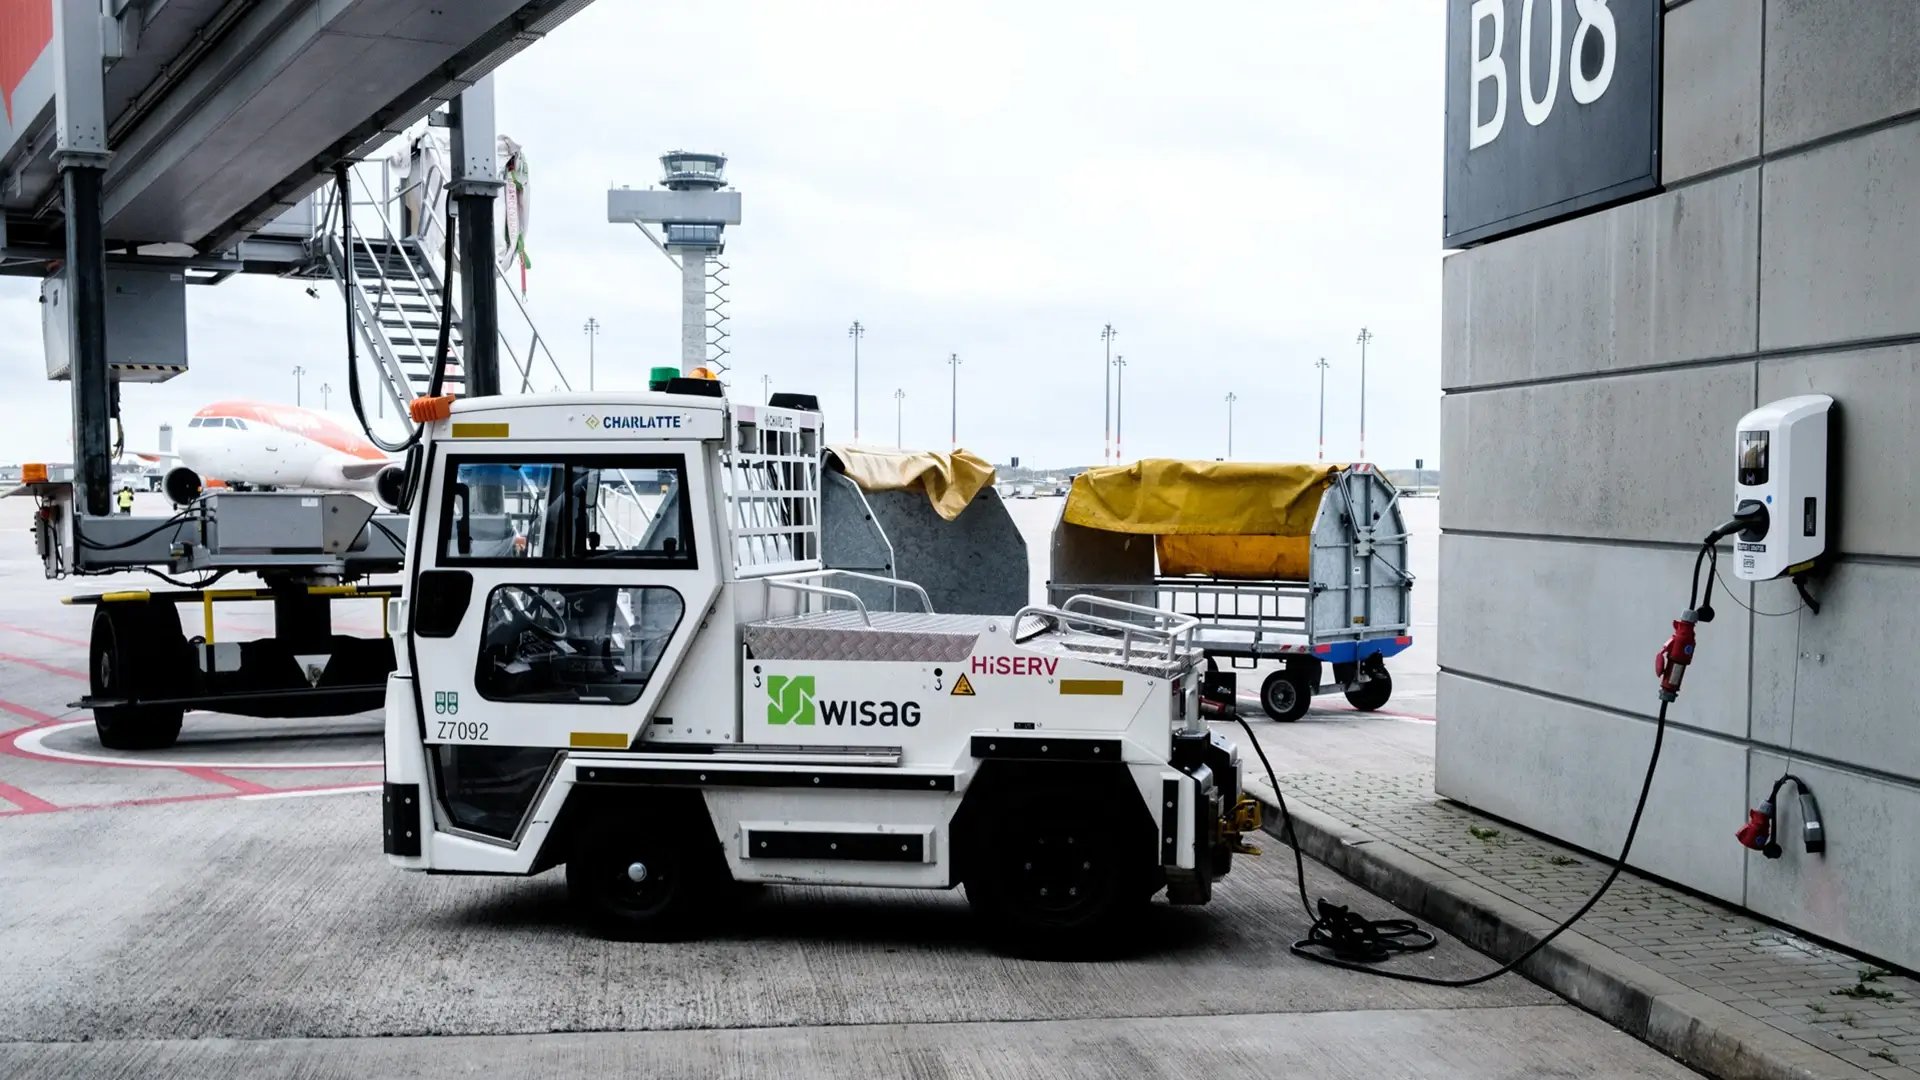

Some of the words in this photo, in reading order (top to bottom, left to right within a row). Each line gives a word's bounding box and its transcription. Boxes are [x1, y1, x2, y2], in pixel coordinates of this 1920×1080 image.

[1470, 0, 1617, 151] B08
[603, 416, 681, 428] CHARLATTE
[971, 656, 1059, 676] HiSERV
[437, 721, 489, 740] Z7092
